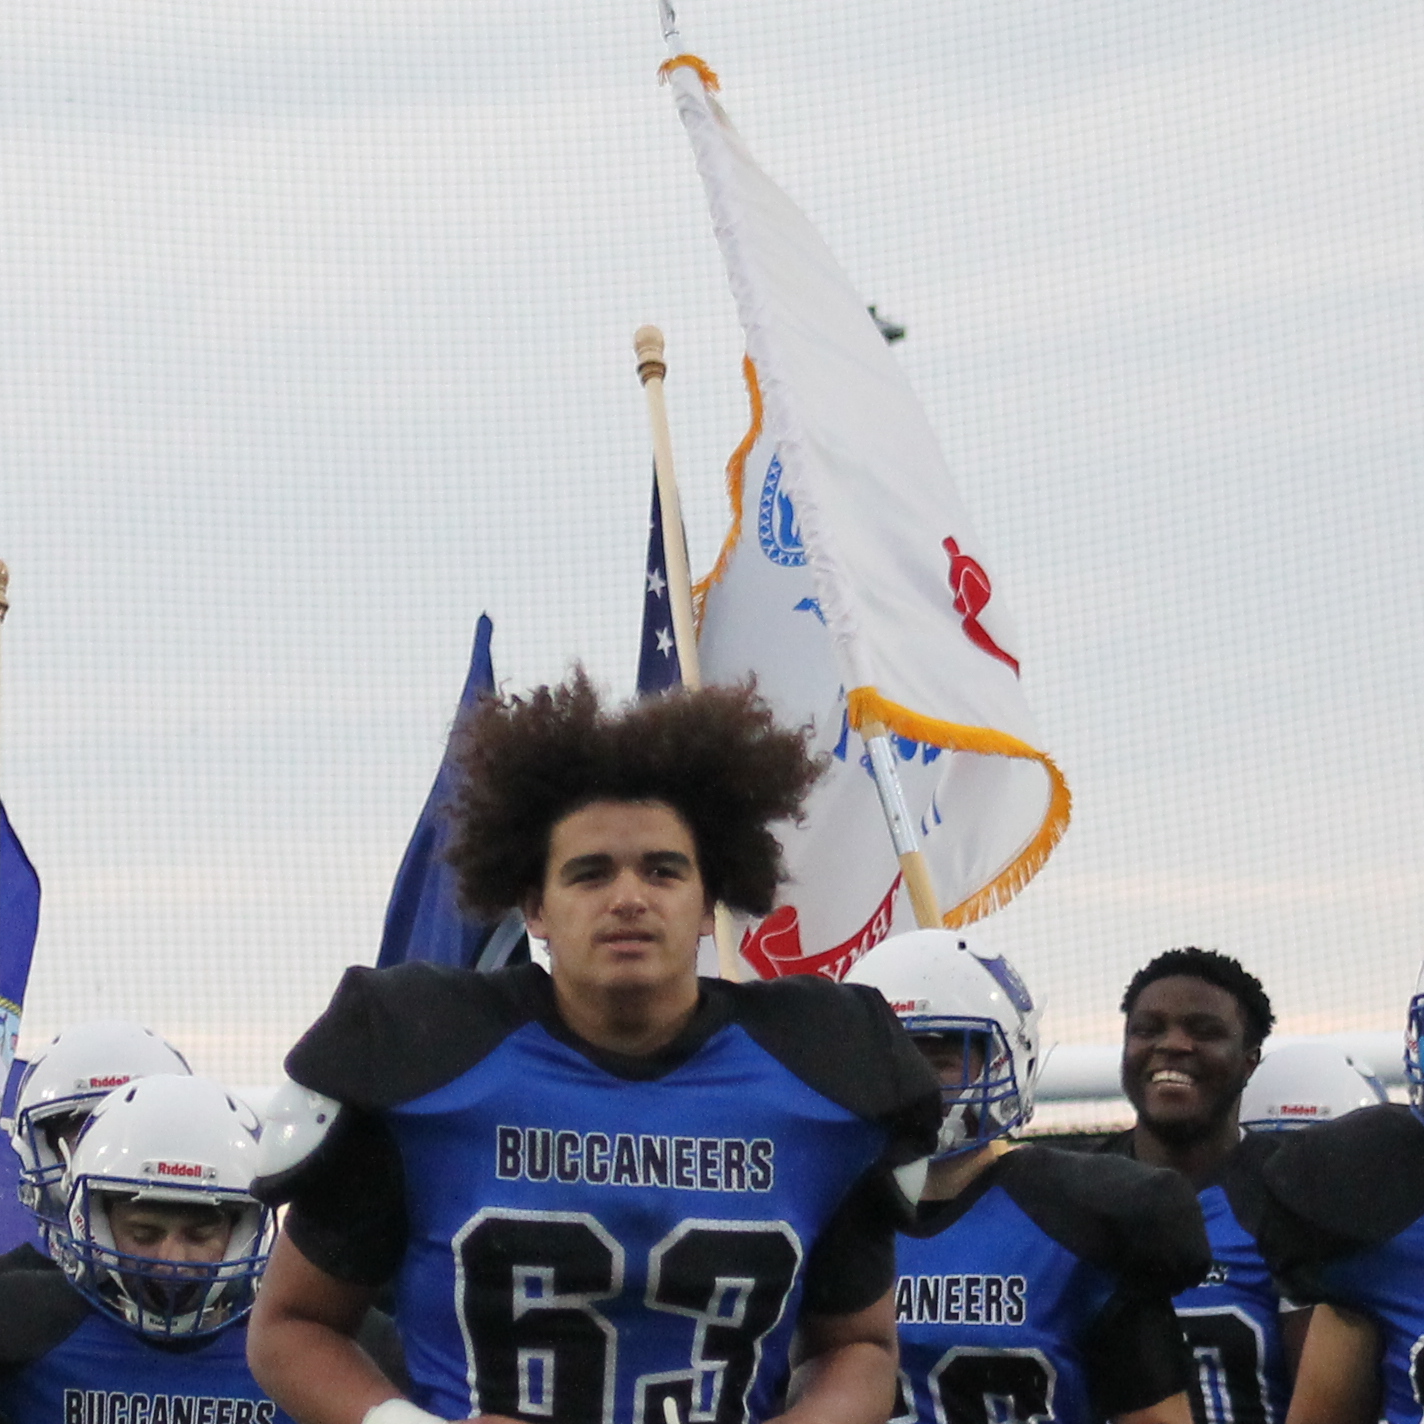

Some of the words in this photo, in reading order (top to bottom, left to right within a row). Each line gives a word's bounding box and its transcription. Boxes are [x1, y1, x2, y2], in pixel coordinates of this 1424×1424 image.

[158, 1161, 203, 1177] Riddell
[496, 1125, 774, 1192] BUCCANEERS
[895, 1274, 1027, 1326] ANEERS
